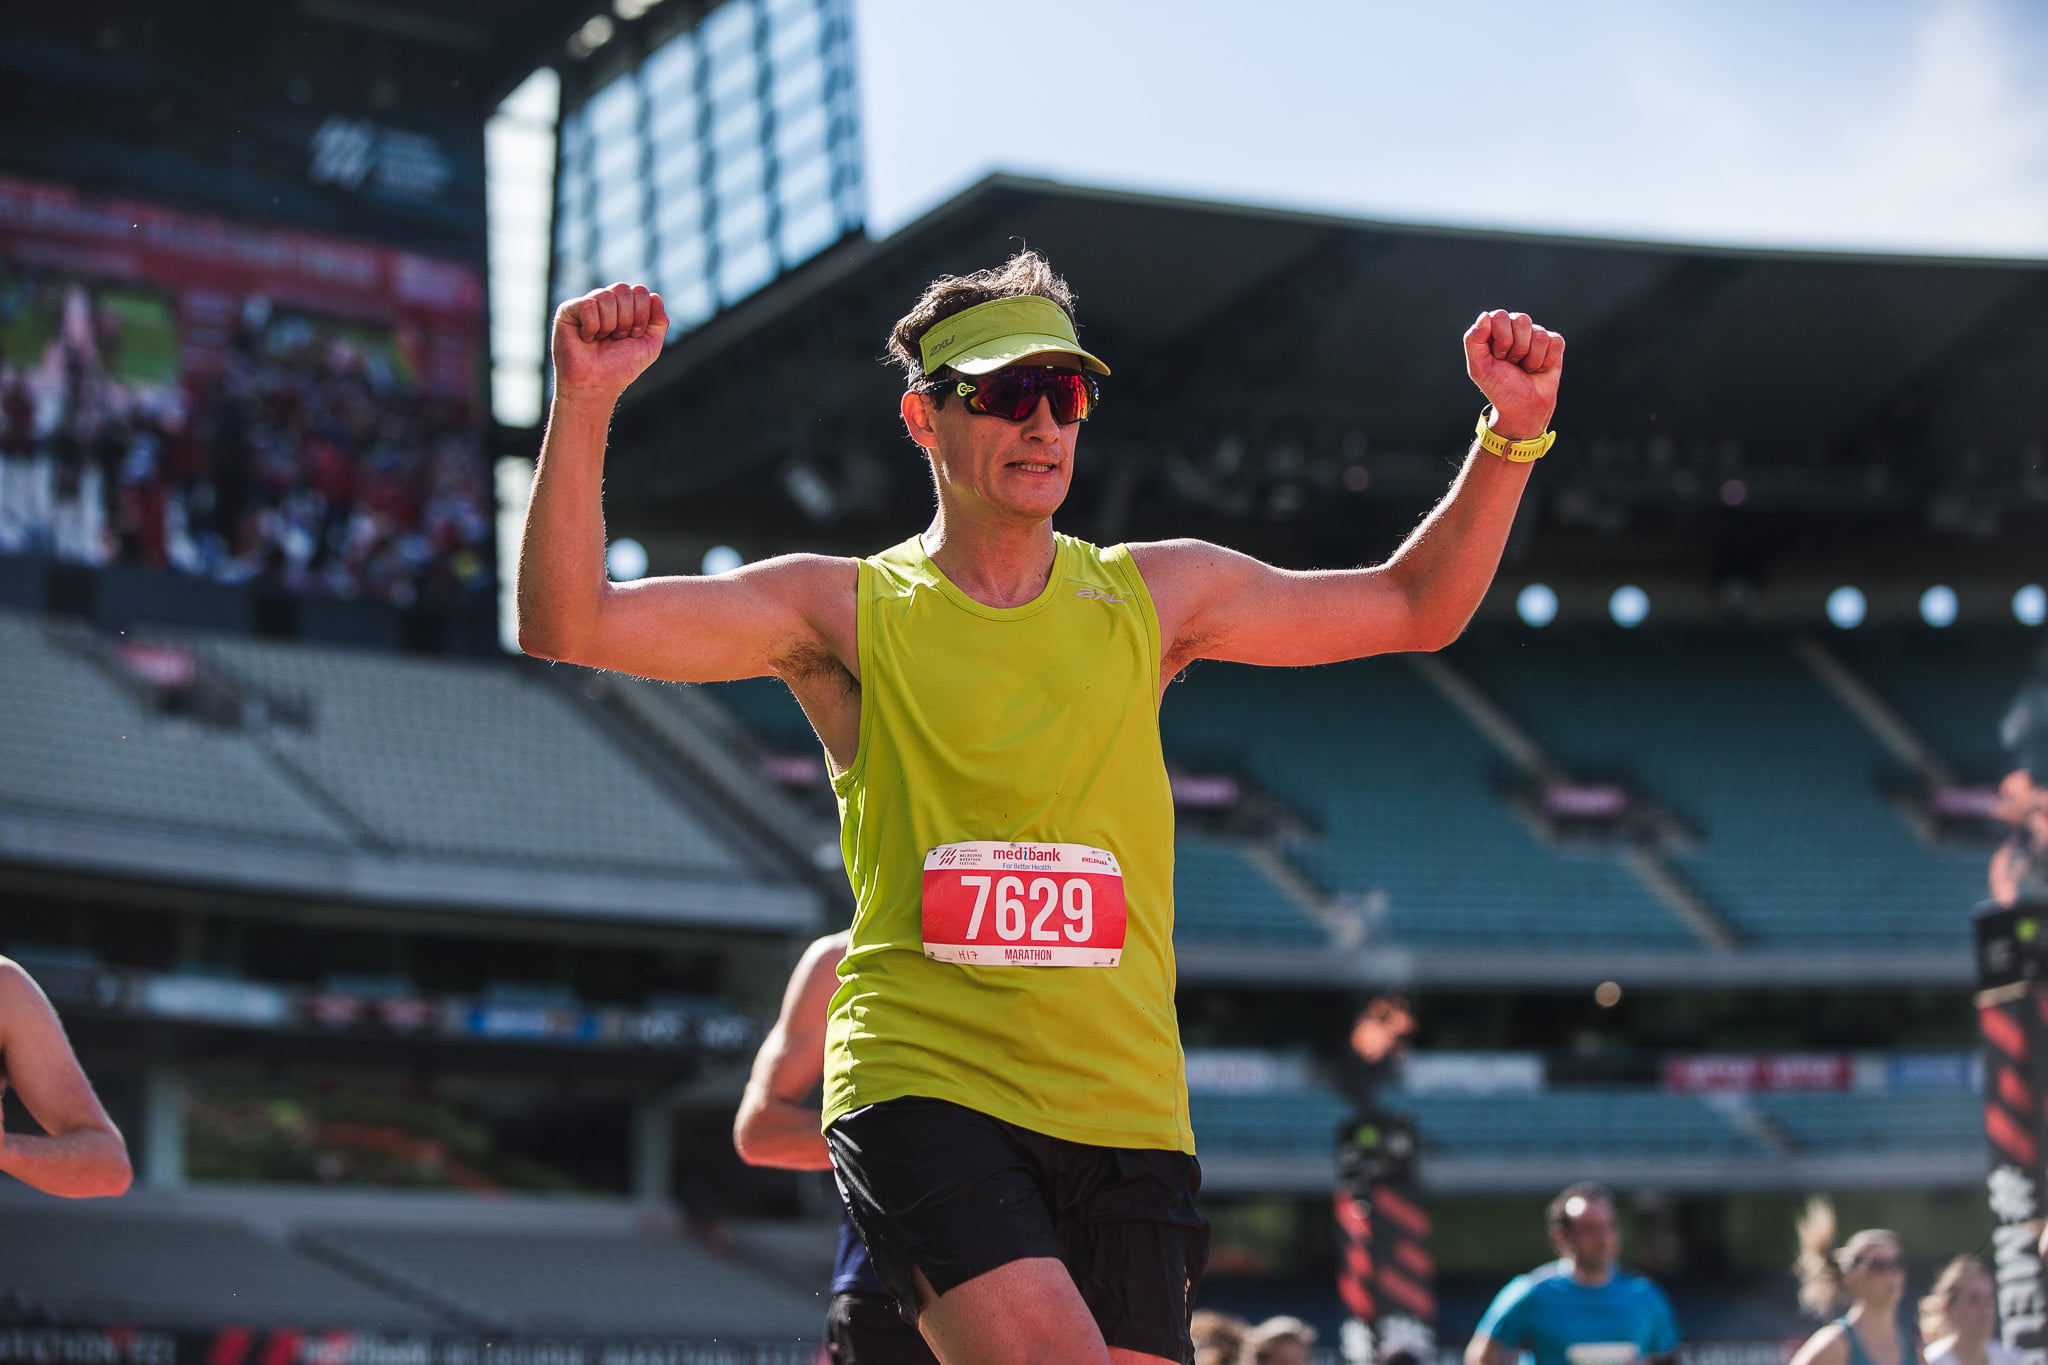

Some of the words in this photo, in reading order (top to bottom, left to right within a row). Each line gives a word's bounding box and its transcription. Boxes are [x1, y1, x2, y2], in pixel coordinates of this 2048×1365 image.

[929, 334, 956, 358] 2XU
[992, 846, 1062, 862] medibank
[960, 875, 1093, 943] 7629
[1004, 948, 1052, 961] MARATHON
[1986, 1165, 2047, 1365] #MEL
